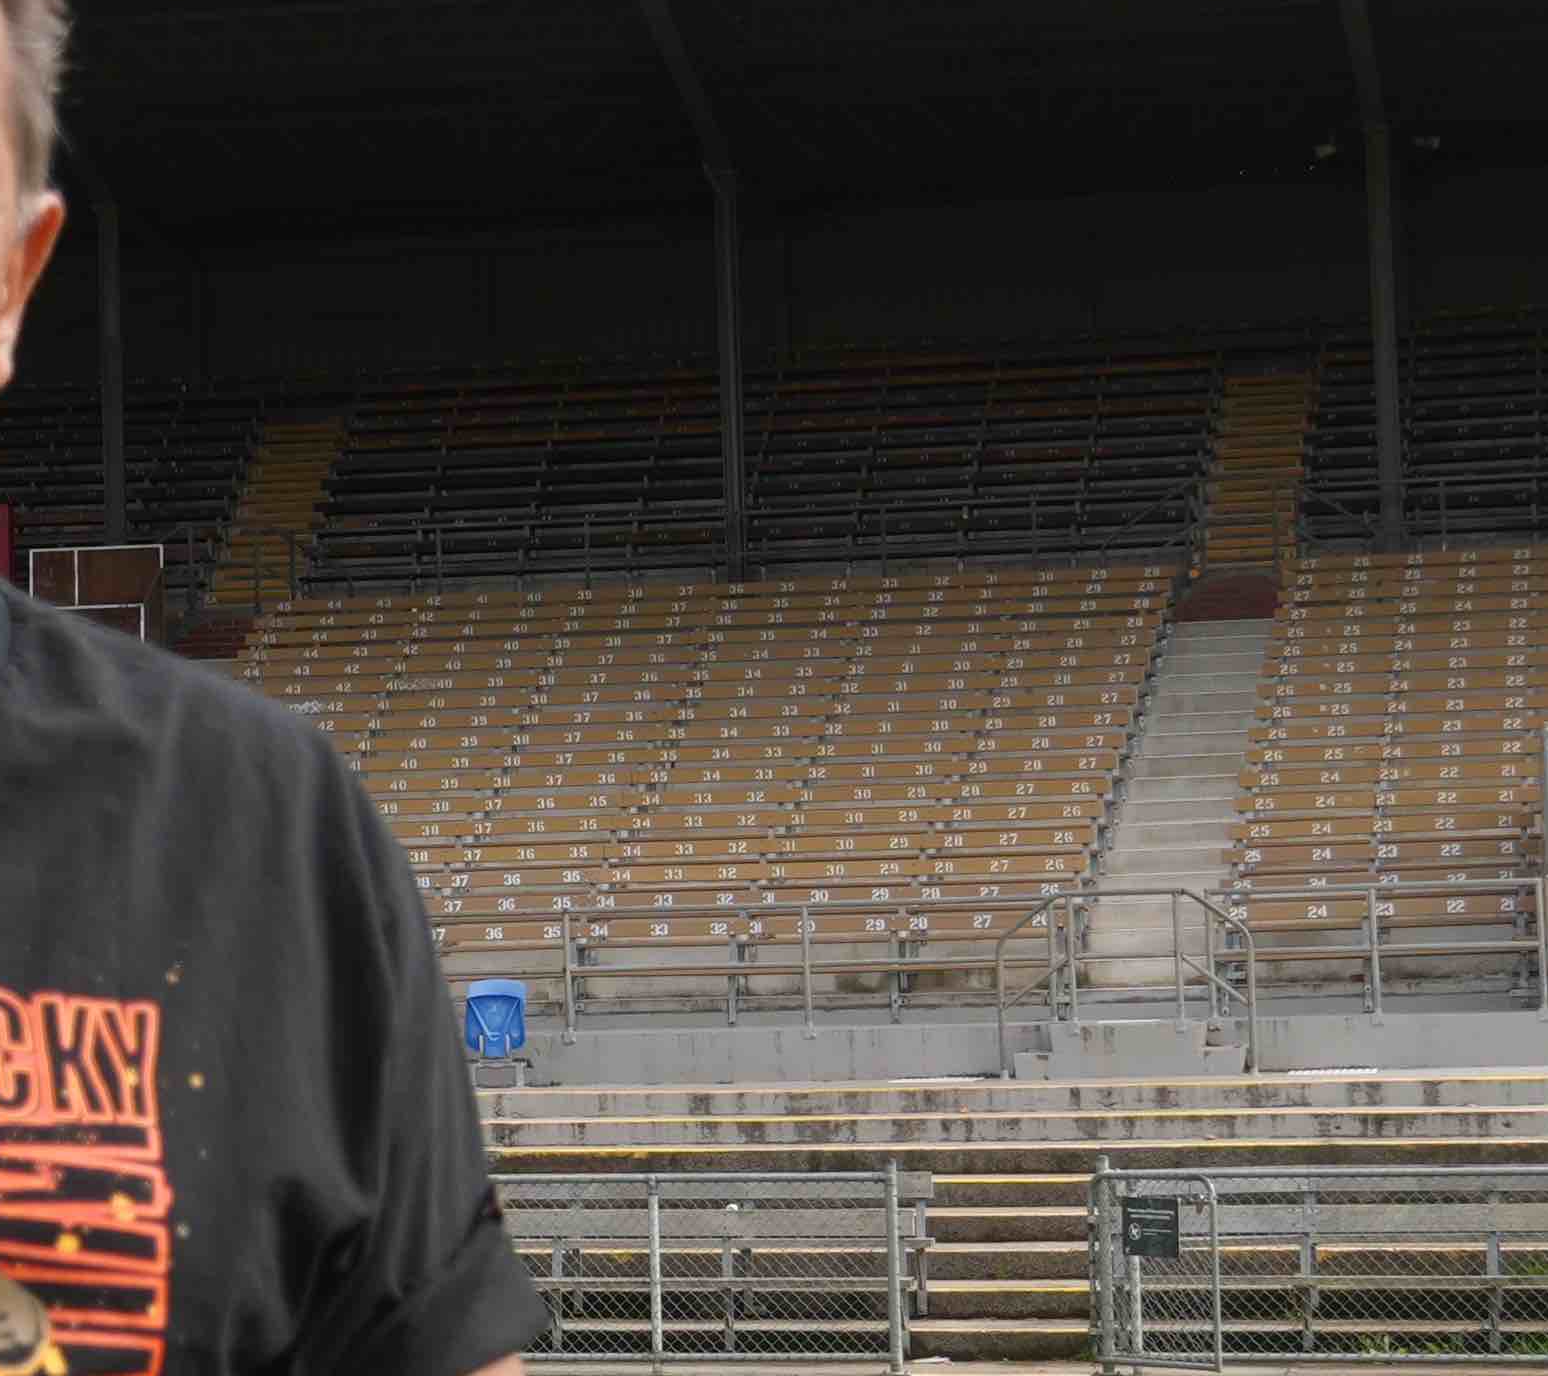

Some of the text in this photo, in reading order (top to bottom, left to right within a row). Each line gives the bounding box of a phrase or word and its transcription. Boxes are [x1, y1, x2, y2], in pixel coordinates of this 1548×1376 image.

[1504, 696, 1525, 709] 22
[1255, 789, 1513, 810] 25 24 23 22 21
[1244, 841, 1515, 863] 25 24 23 22 21
[451, 874, 469, 887] 37
[503, 873, 521, 886] 36
[612, 869, 631, 881] 34
[664, 868, 683, 880] 33
[718, 867, 737, 879] 32
[772, 866, 785, 878] 31
[826, 864, 845, 876] 30
[880, 863, 899, 875] 29
[990, 859, 1009, 873] 27
[1045, 858, 1065, 871] 26
[1307, 897, 1515, 918] 24 23 22 21
[485, 927, 503, 940] 36
[543, 925, 561, 939] 35
[590, 924, 609, 937] 34
[650, 923, 669, 936] 33
[710, 922, 728, 935] 32
[749, 920, 763, 934] 31
[865, 918, 886, 931] 29
[973, 913, 992, 929] 27
